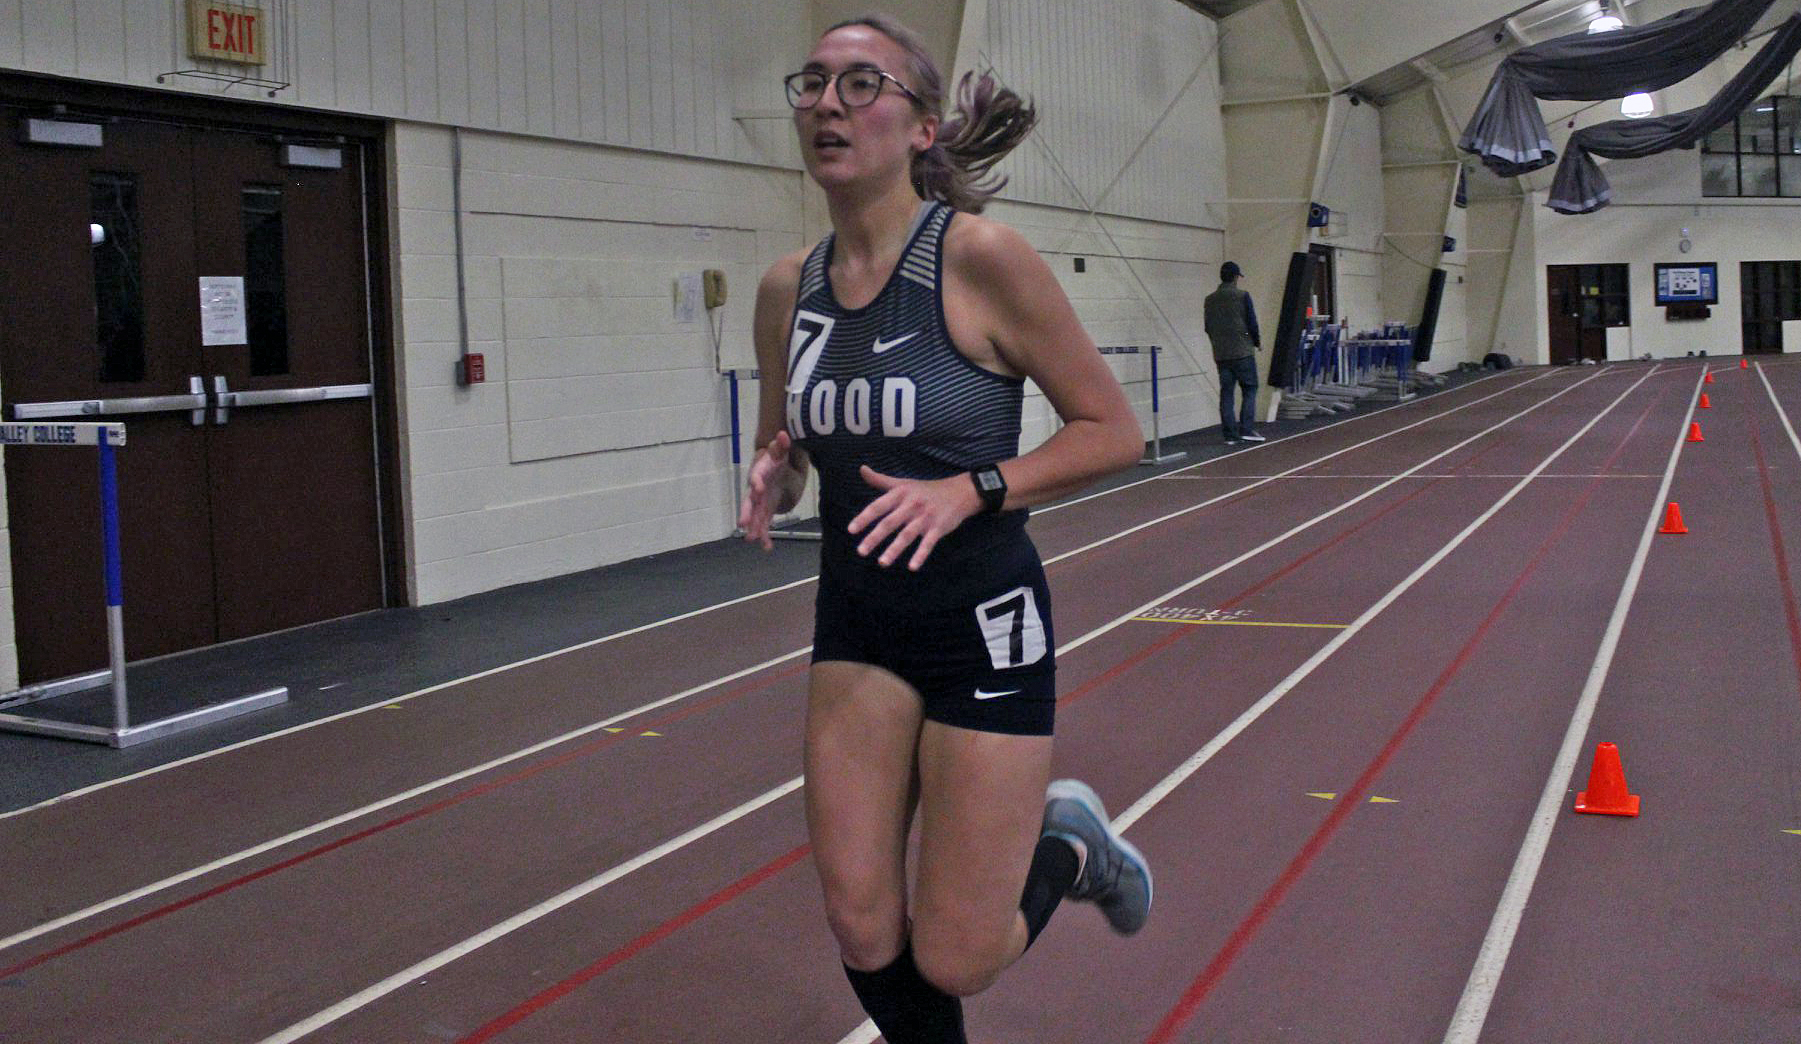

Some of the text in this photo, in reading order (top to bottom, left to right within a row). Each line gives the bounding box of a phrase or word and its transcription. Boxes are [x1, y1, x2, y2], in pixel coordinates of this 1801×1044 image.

[208, 9, 256, 54] EXIT
[788, 318, 826, 387] 7
[33, 425, 76, 443] COLLEGE
[786, 377, 916, 439] HOOD
[984, 592, 1026, 667] 7
